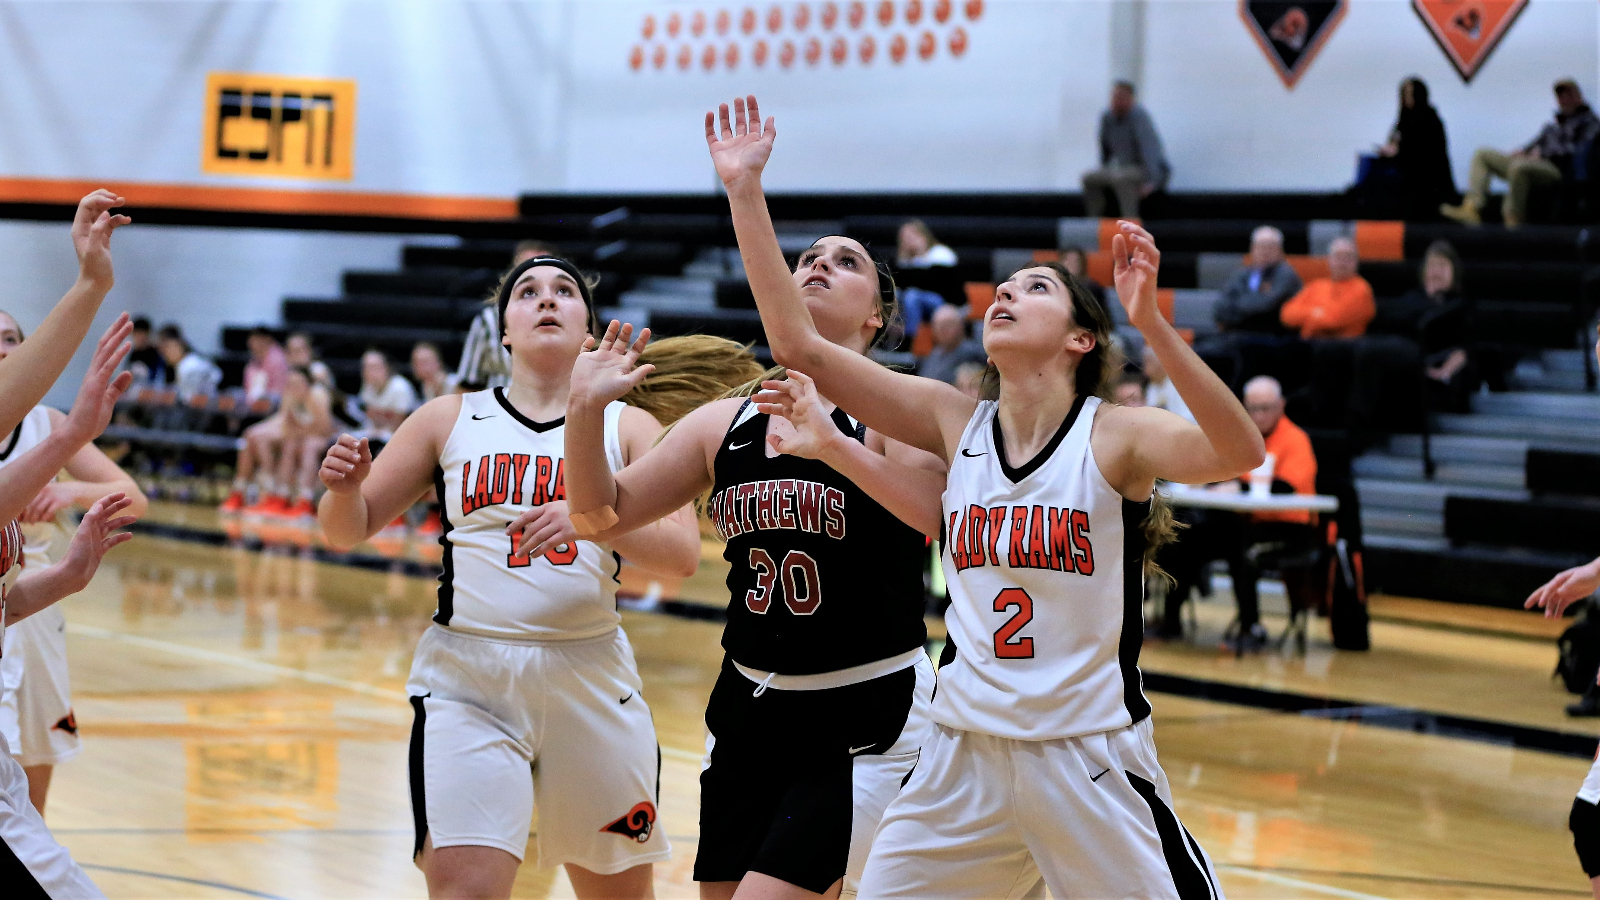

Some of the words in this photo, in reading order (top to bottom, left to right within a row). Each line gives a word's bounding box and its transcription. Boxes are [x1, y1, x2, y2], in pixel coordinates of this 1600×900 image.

[216, 88, 334, 167] ESPN
[461, 453, 531, 517] LADY
[531, 455, 567, 506] RA
[711, 479, 846, 542] MATHEWS
[949, 504, 1008, 575] LADY
[1008, 505, 1095, 576] RAMS
[745, 548, 822, 616] 30
[992, 587, 1035, 659] 2
